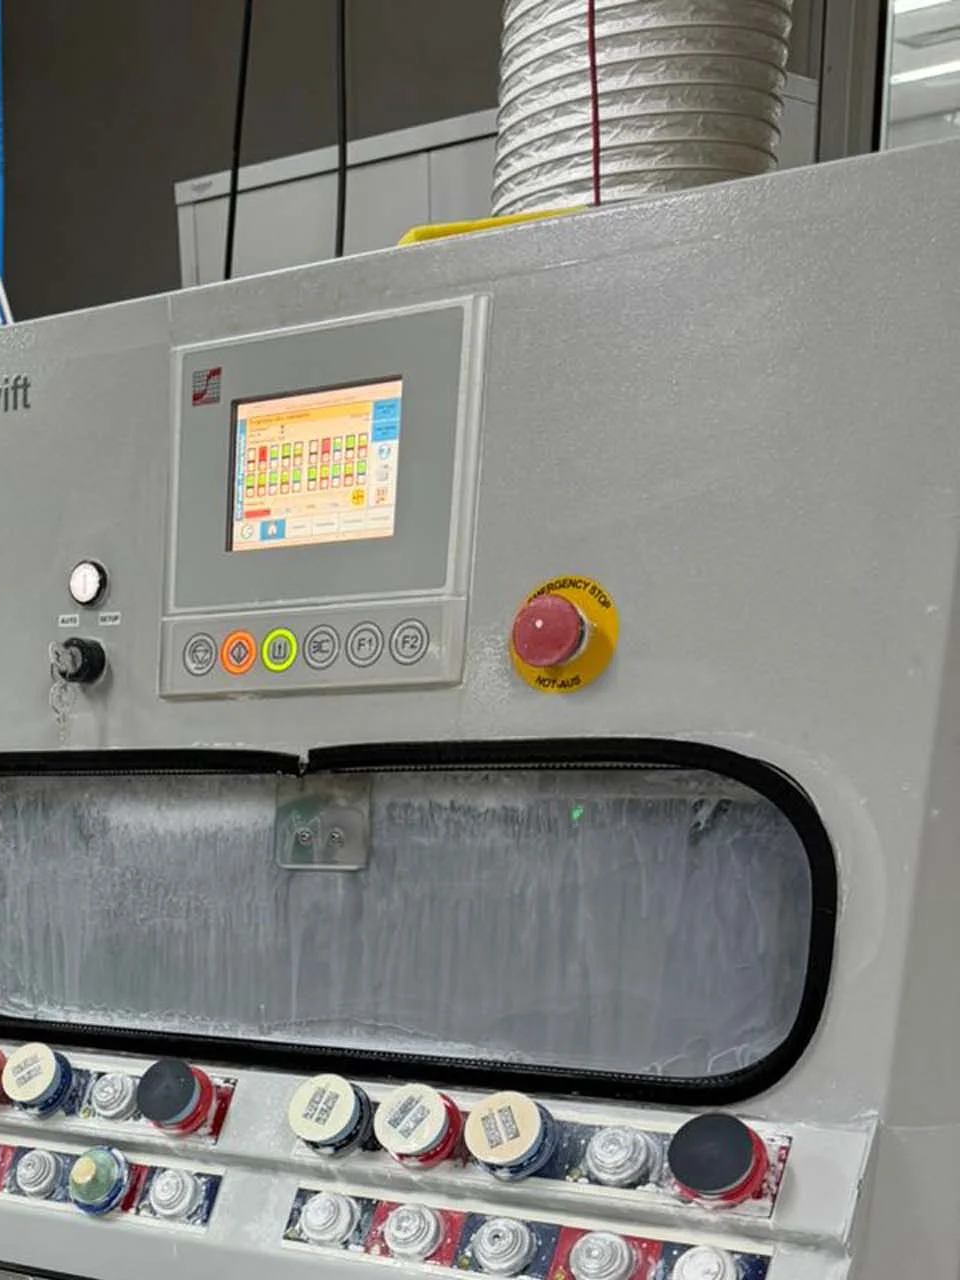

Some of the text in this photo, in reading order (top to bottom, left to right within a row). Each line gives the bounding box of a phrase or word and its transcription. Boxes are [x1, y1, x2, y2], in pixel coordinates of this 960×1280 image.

[588, 585, 612, 609] STOP
[357, 638, 373, 651] F1
[401, 635, 419, 649] F2
